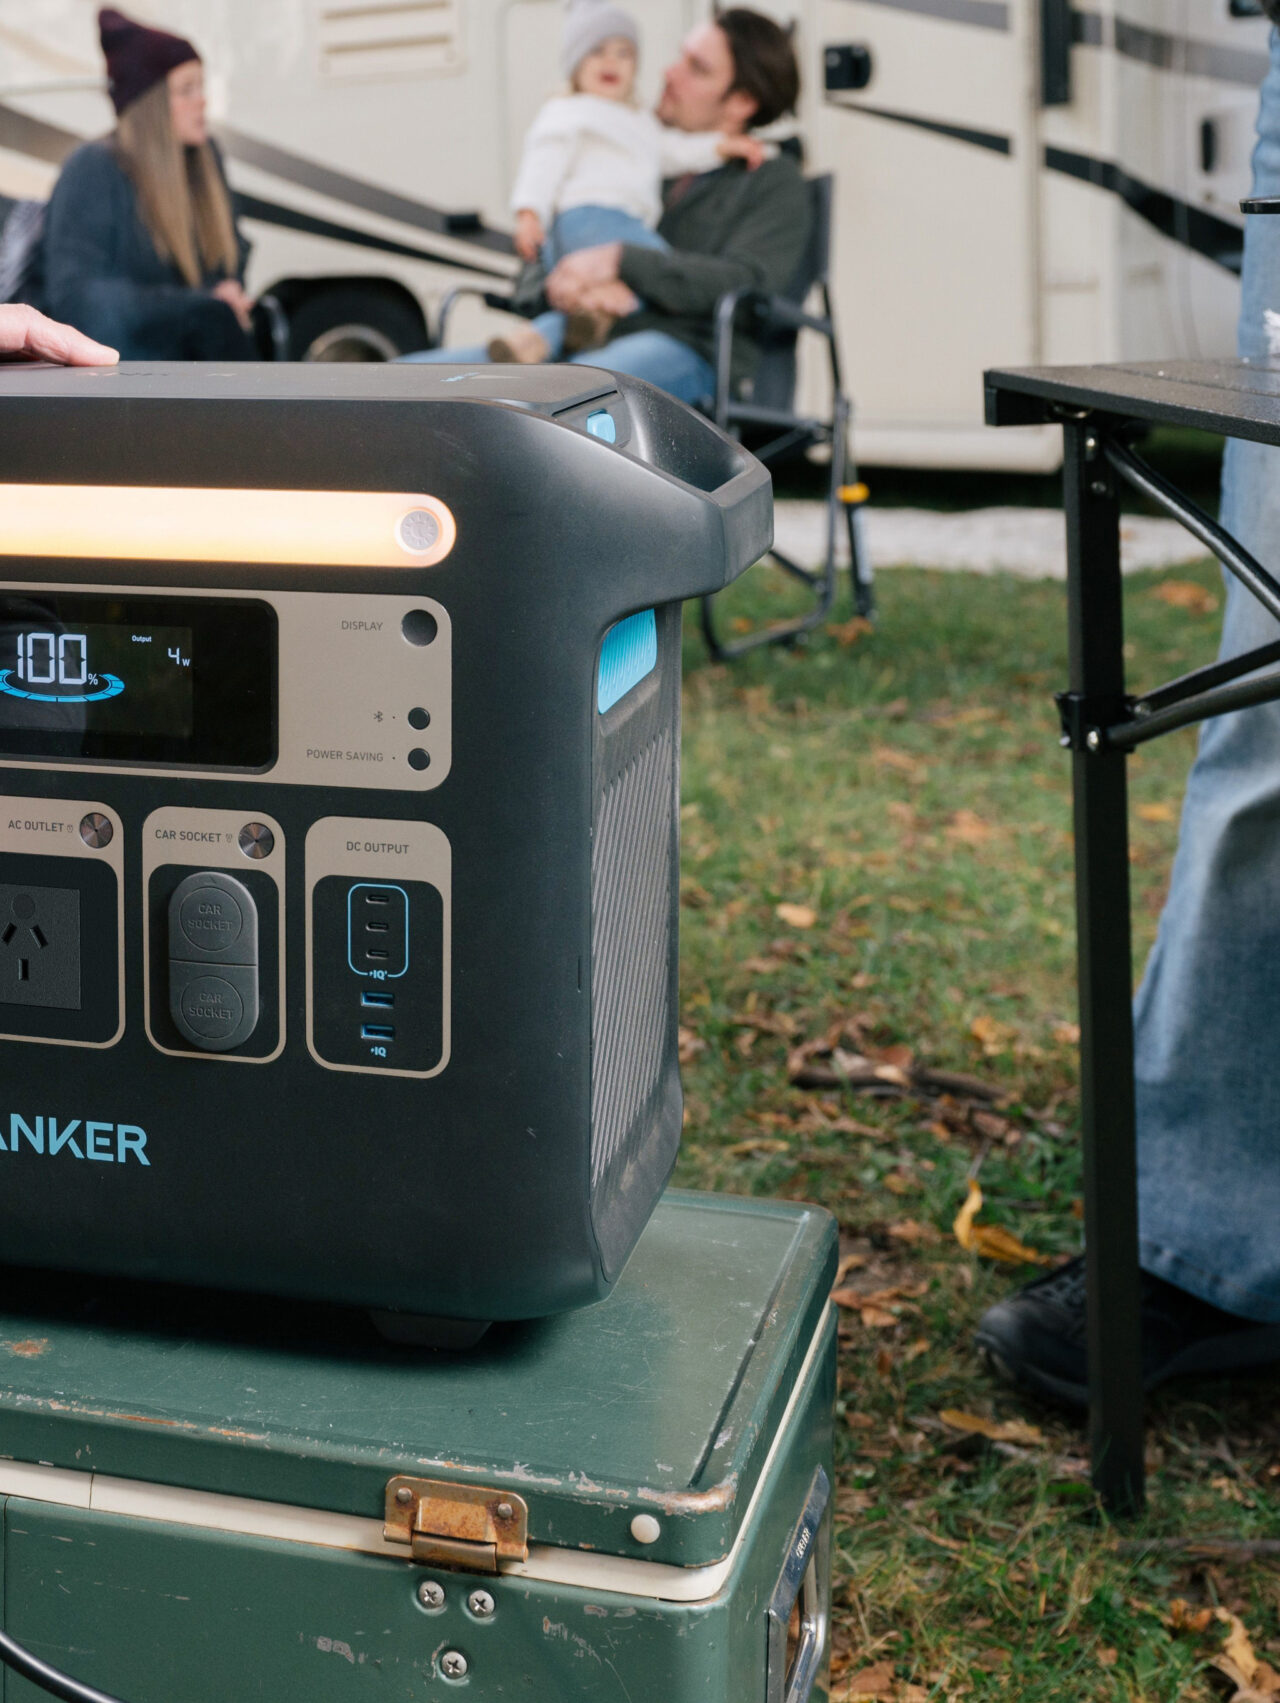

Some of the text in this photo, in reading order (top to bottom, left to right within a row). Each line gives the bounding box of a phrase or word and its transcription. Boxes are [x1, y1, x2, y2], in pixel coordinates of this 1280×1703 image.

[341, 620, 384, 631] DISPLAY
[131, 634, 152, 643] Output
[306, 748, 384, 762] POWER SAVING
[8, 820, 64, 832] AC OUTLET
[155, 830, 221, 842] CAR SOCKET
[346, 841, 410, 854] DC OUTPUT
[198, 904, 222, 916] CAR
[188, 920, 232, 931] SOCKET
[200, 992, 222, 1004] CAR
[189, 1007, 234, 1020] SOCKET
